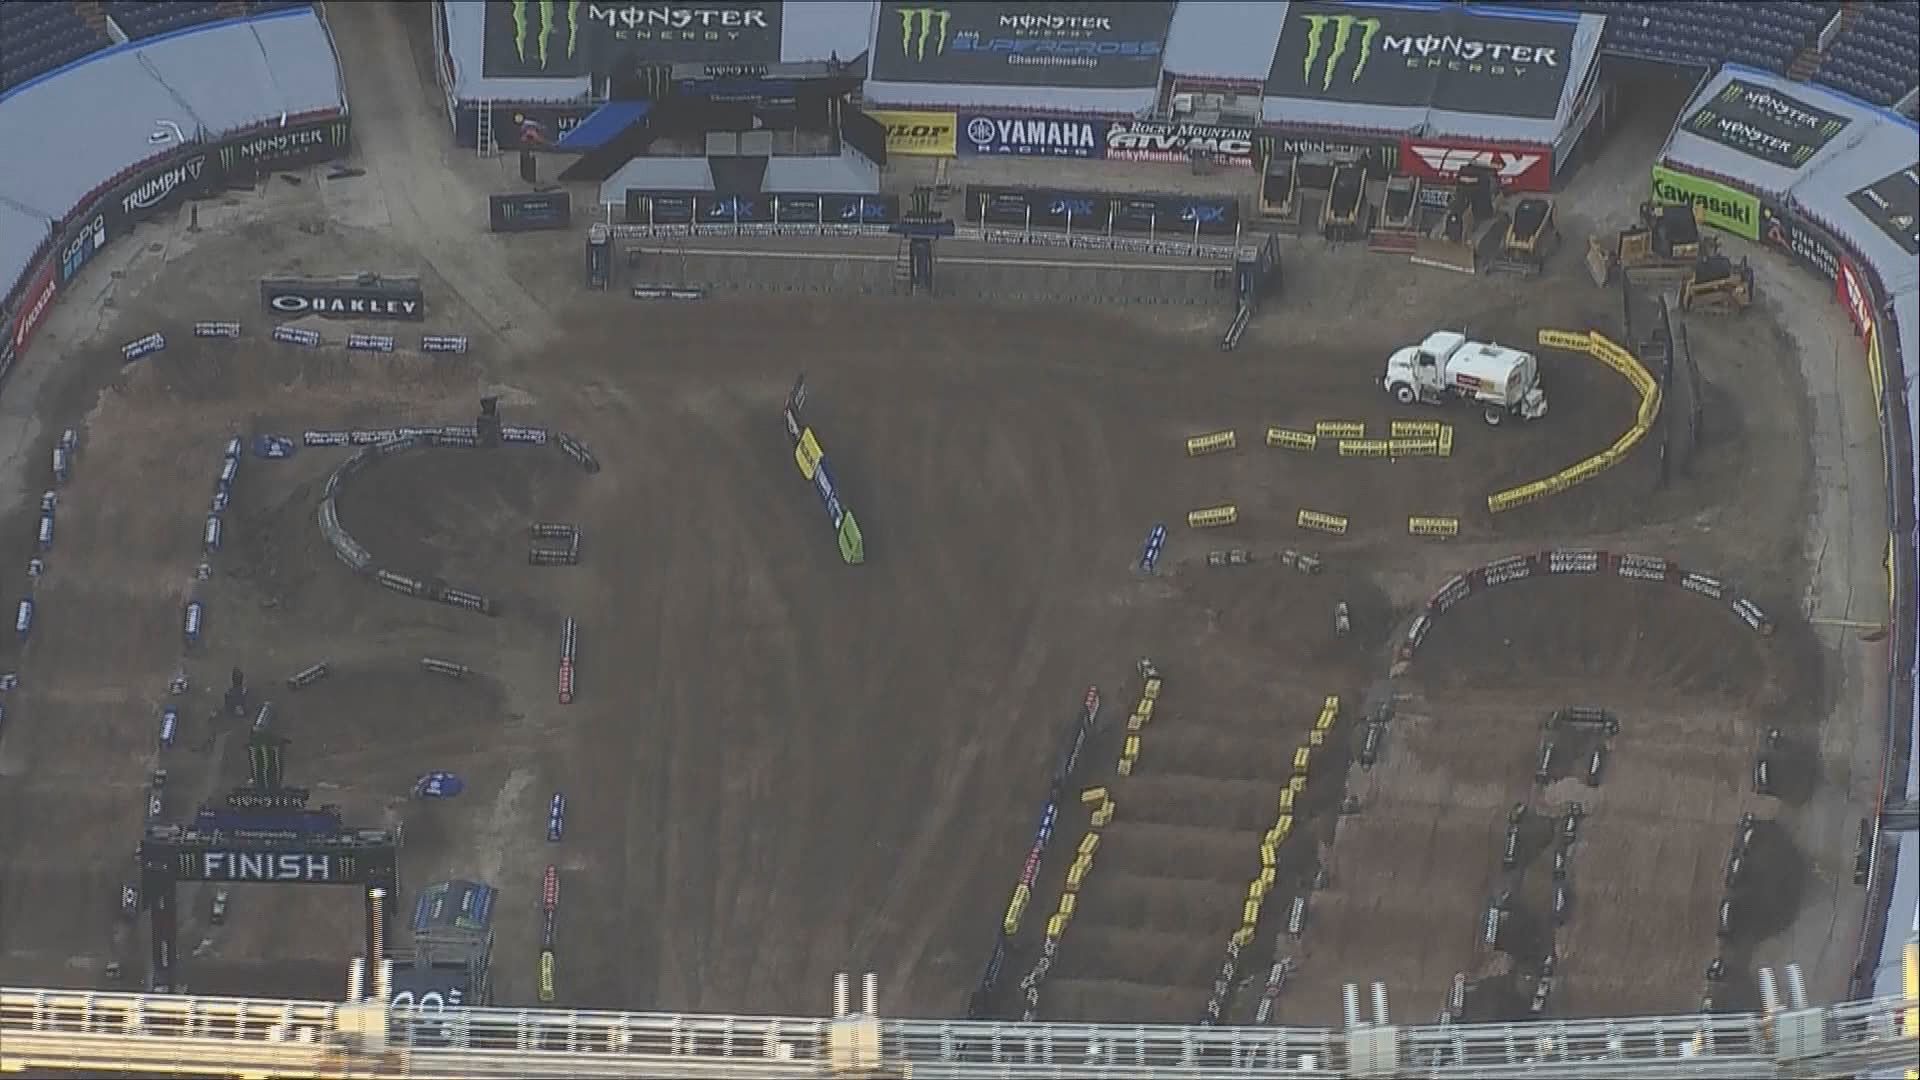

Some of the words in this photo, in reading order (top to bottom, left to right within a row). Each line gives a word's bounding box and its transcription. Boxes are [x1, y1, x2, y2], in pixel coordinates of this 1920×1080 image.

[589, 4, 768, 28] MONSTER
[1000, 13, 1112, 30] MONSTER
[616, 30, 740, 41] ENERGY
[1008, 55, 1098, 68] Championship
[1383, 33, 1558, 66] MONSTER
[1407, 58, 1526, 77] ENERGY
[1745, 91, 1818, 128] MONSTER
[997, 119, 1094, 148] YAMAHA
[1131, 121, 1174, 135] ROCKY
[1177, 124, 1252, 139] MOUNTAIN
[1717, 117, 1790, 152] MONSTER
[241, 129, 322, 157] MONSTER
[122, 166, 186, 214] TRIUMPH
[313, 298, 416, 314] OAKLEY
[204, 853, 329, 879] FINISH
